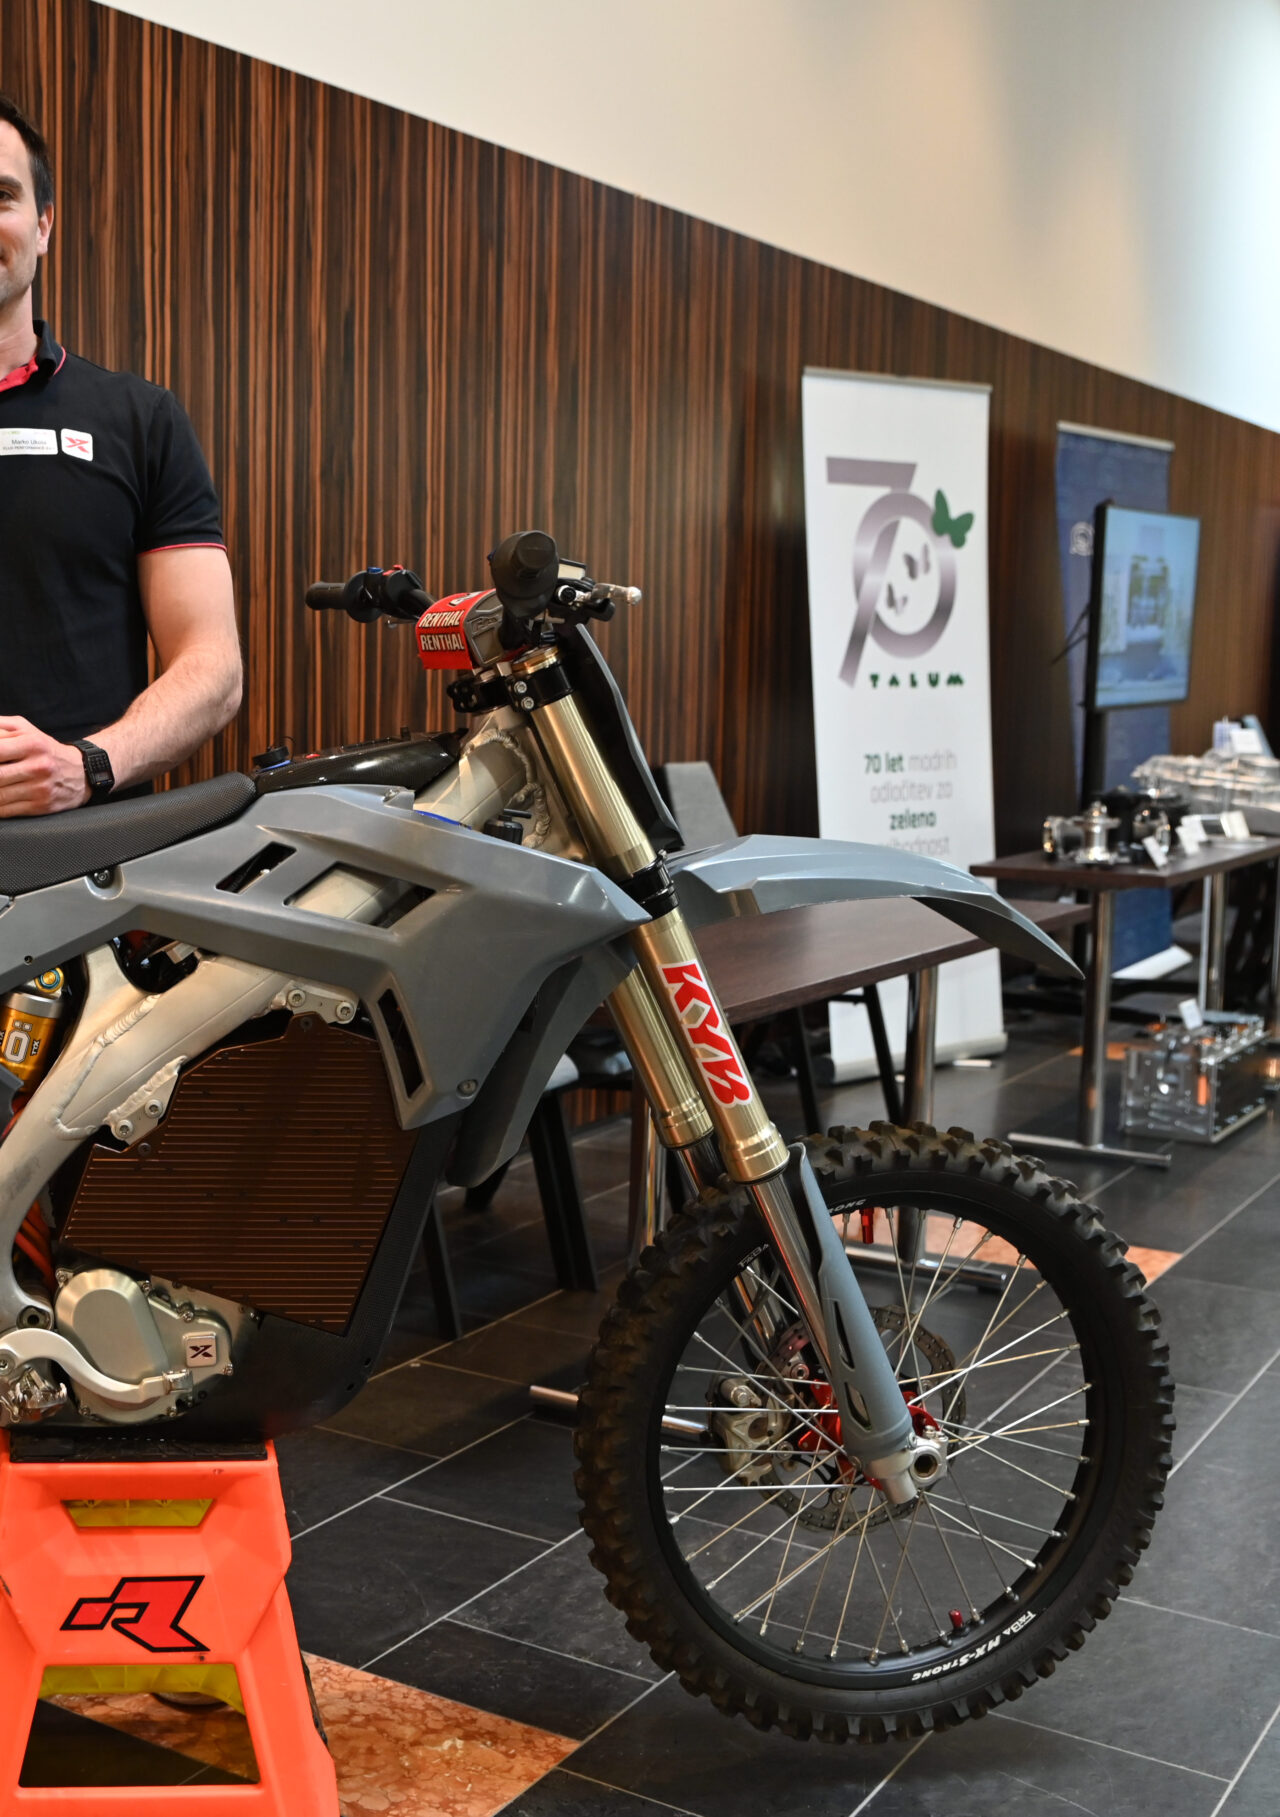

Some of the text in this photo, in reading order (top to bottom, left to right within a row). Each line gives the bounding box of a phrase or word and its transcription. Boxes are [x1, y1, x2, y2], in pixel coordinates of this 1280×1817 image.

[419, 610, 465, 628] RENTHAL
[420, 632, 465, 651] RENTHAL
[869, 672, 964, 689] TALUM
[864, 753, 881, 774] 70
[885, 752, 904, 773] let
[657, 959, 752, 1108] KYB
[31, 1039, 41, 1056] TTX
